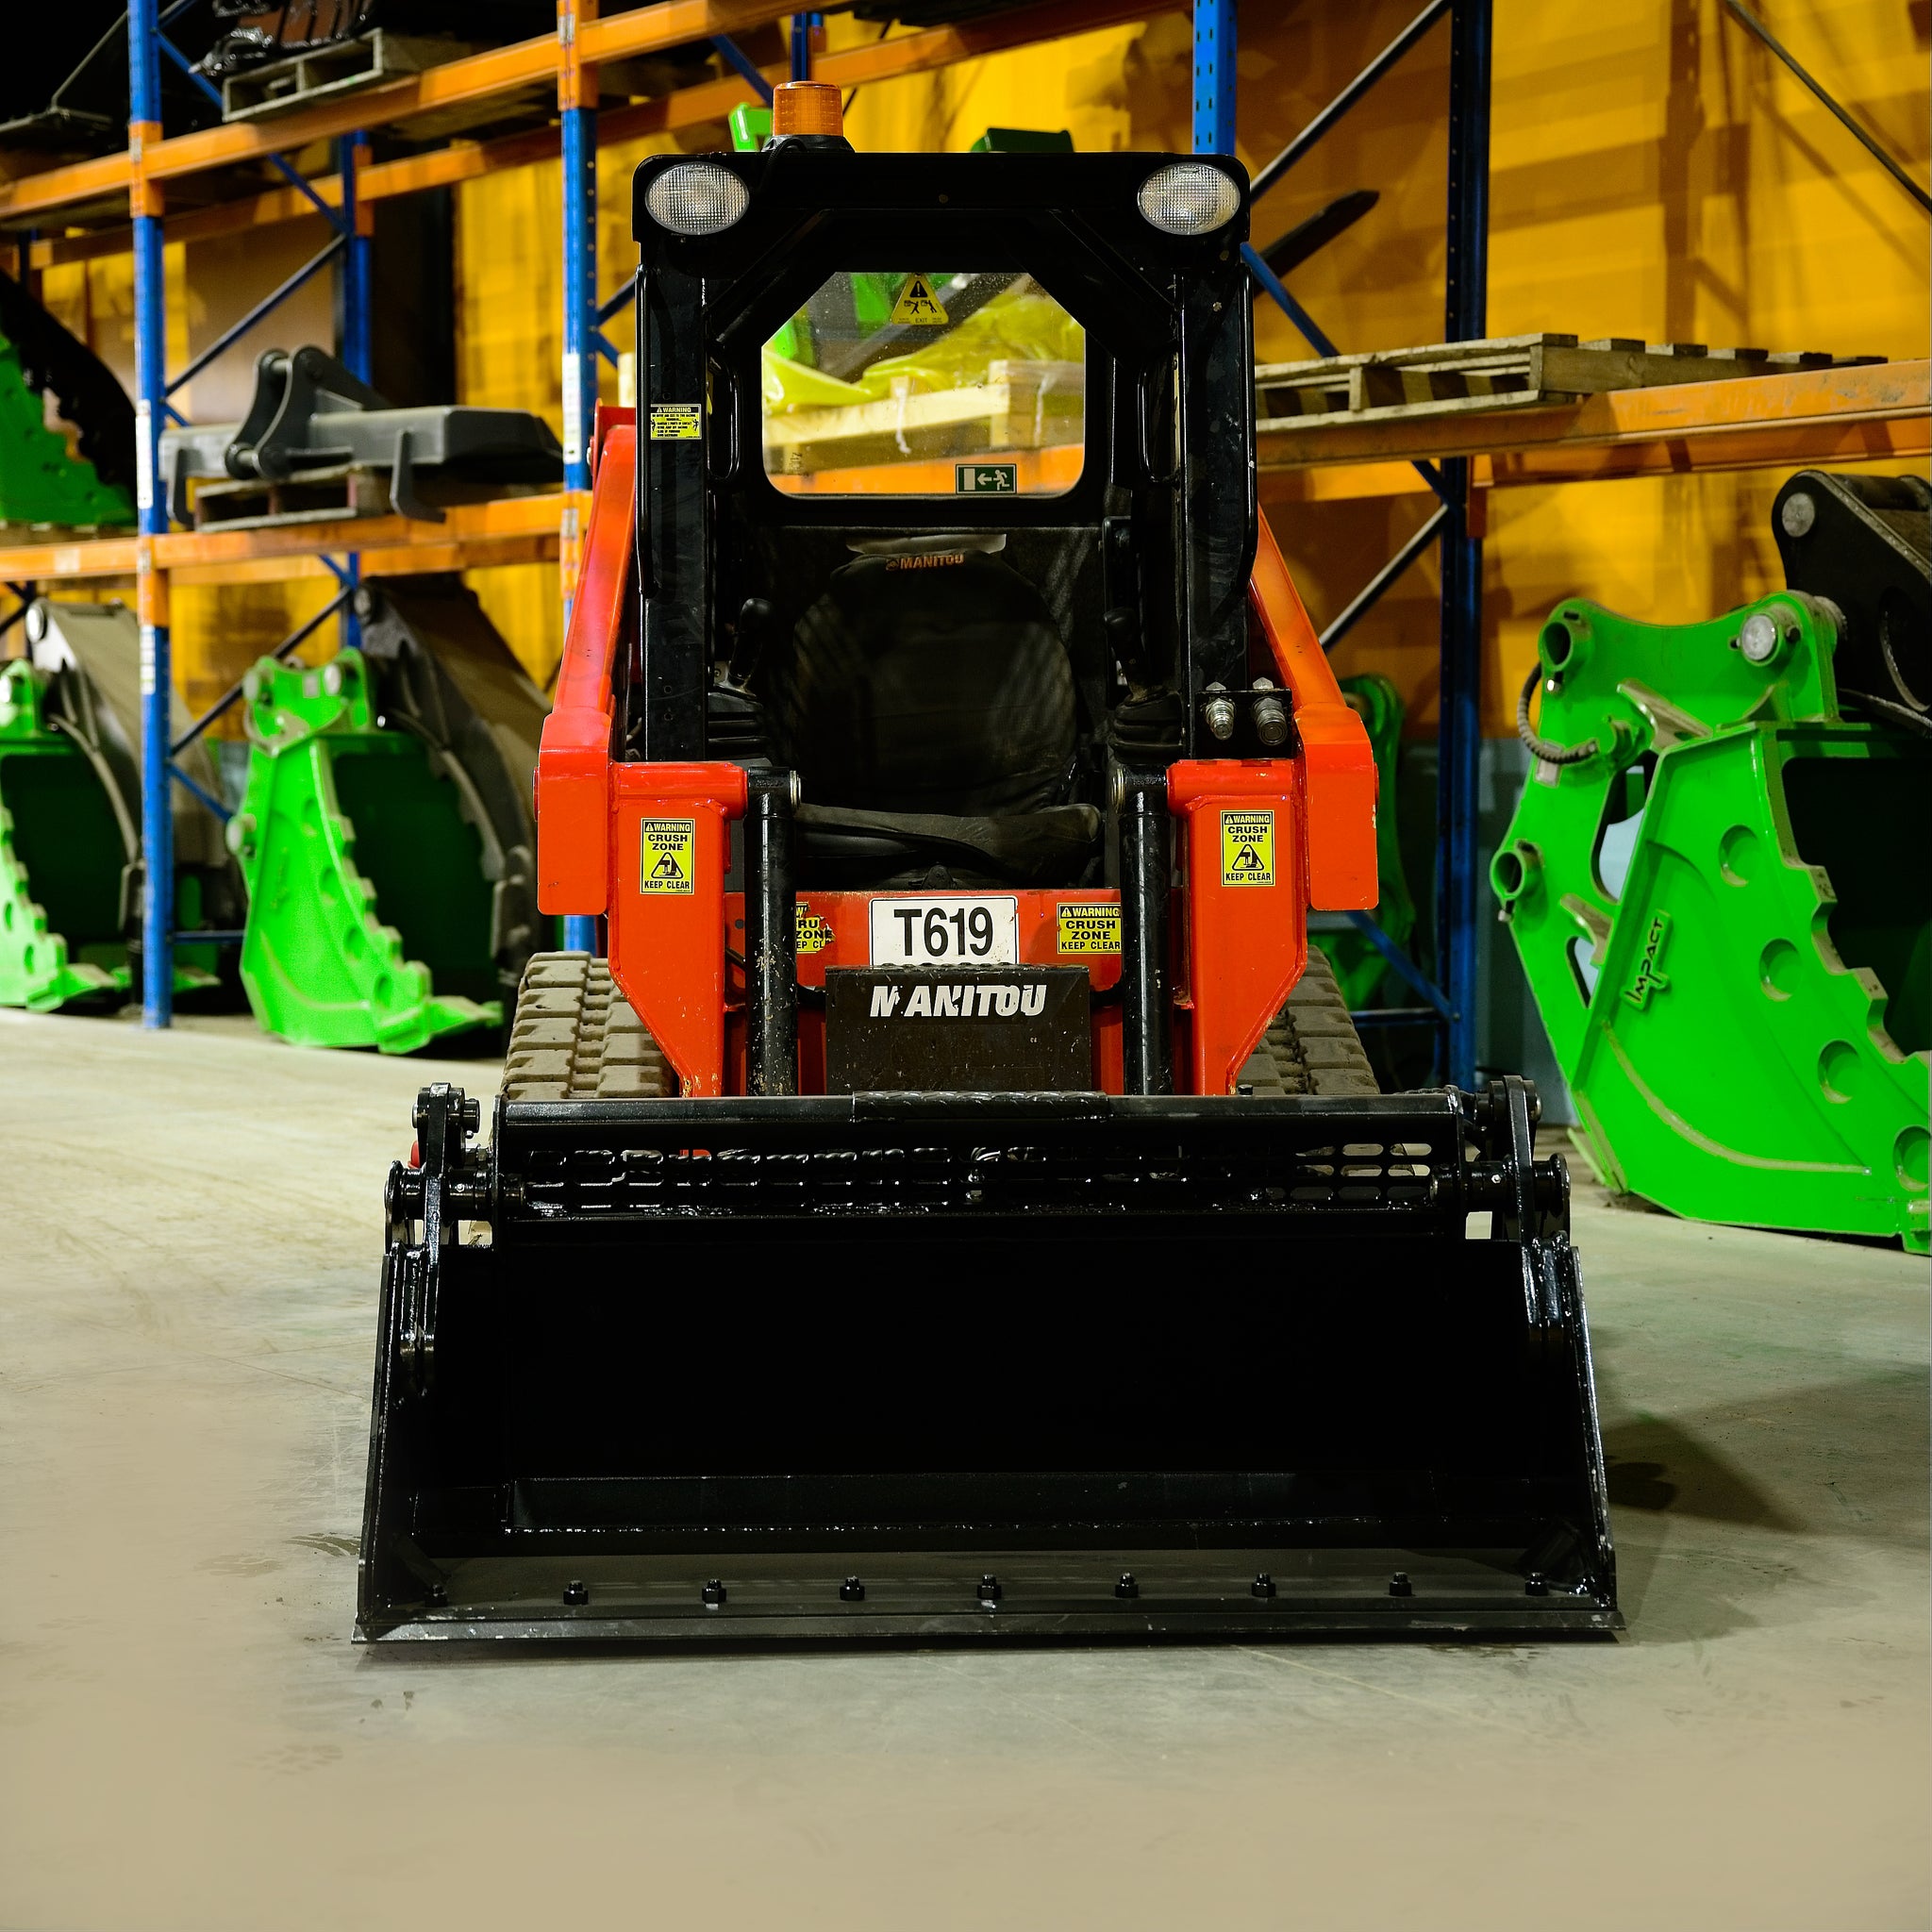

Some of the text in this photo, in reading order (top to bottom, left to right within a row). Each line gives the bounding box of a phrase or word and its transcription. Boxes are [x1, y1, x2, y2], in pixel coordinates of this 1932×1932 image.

[900, 553, 964, 570] MANITOU
[1233, 814, 1270, 824] WARNING
[653, 823, 691, 832] WARNING
[1227, 825, 1268, 834] CRUSH
[647, 834, 688, 842] CRUSH
[652, 842, 684, 851] ZONE
[1225, 873, 1271, 881] KEEP CLEAR
[644, 880, 690, 890] KEEP CLEAR
[1072, 907, 1120, 917] WARNING
[1065, 920, 1116, 929] CRUSH
[893, 907, 993, 957] T619
[1071, 931, 1111, 940] ZONE
[796, 941, 808, 949] EP
[1061, 941, 1121, 950] KEEP CLEAR
[869, 984, 1047, 1017] MANITOU
